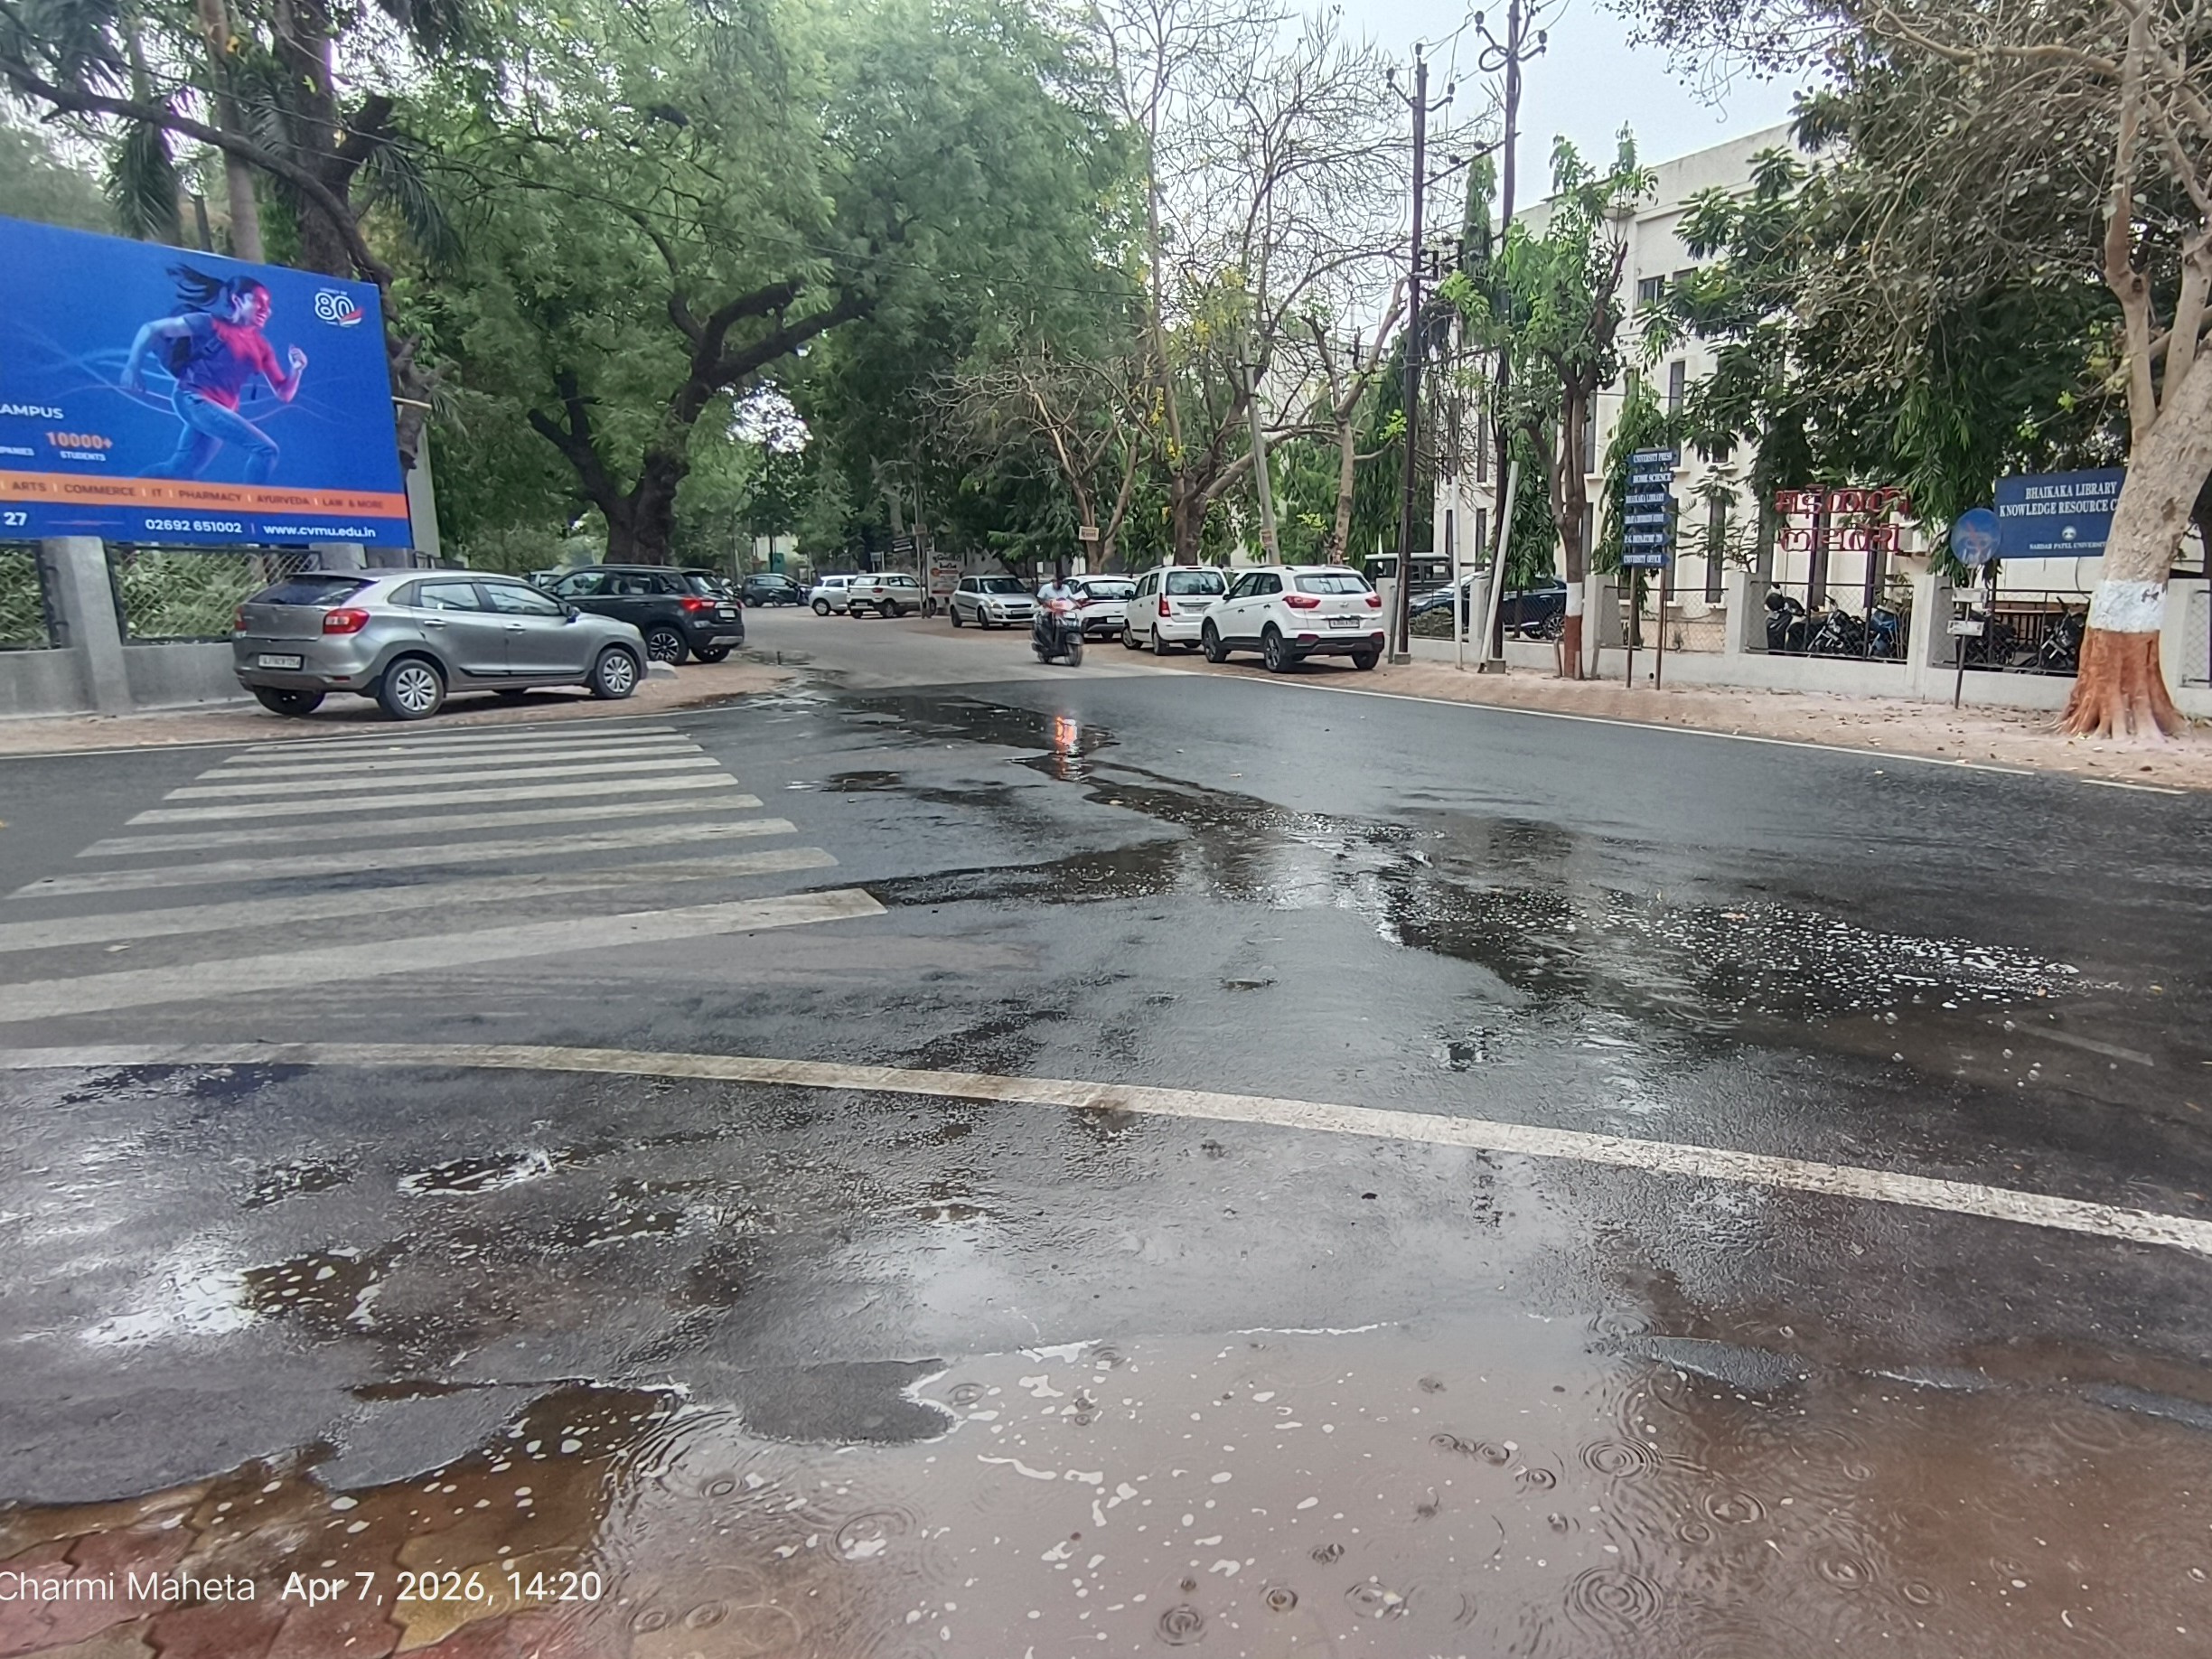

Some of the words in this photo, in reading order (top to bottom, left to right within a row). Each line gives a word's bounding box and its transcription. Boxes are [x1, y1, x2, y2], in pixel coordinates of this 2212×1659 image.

[0, 403, 64, 419] AMPUS
[46, 431, 113, 449] 10000+
[60, 450, 107, 462] STUDENTS
[12, 482, 46, 492] ARTS
[64, 483, 136, 497] COMMERCE
[152, 488, 163, 497] IT
[178, 490, 242, 502] PHARMACY
[256, 495, 311, 506] AYURVEDA
[322, 498, 343, 507] LAW
[357, 500, 384, 509] MORE
[2025, 485, 2074, 500] BHAIKAKA
[2076, 482, 2118, 496] LIBRARY
[2000, 502, 2057, 517] KNOWLEDGE
[2058, 499, 2109, 514] RESOURCE
[4, 511, 27, 526] 27
[145, 519, 192, 531] 02692
[192, 520, 243, 534] 651002
[263, 524, 377, 538] www.cvmu.edu.in
[2053, 542, 2074, 550] PATEL
